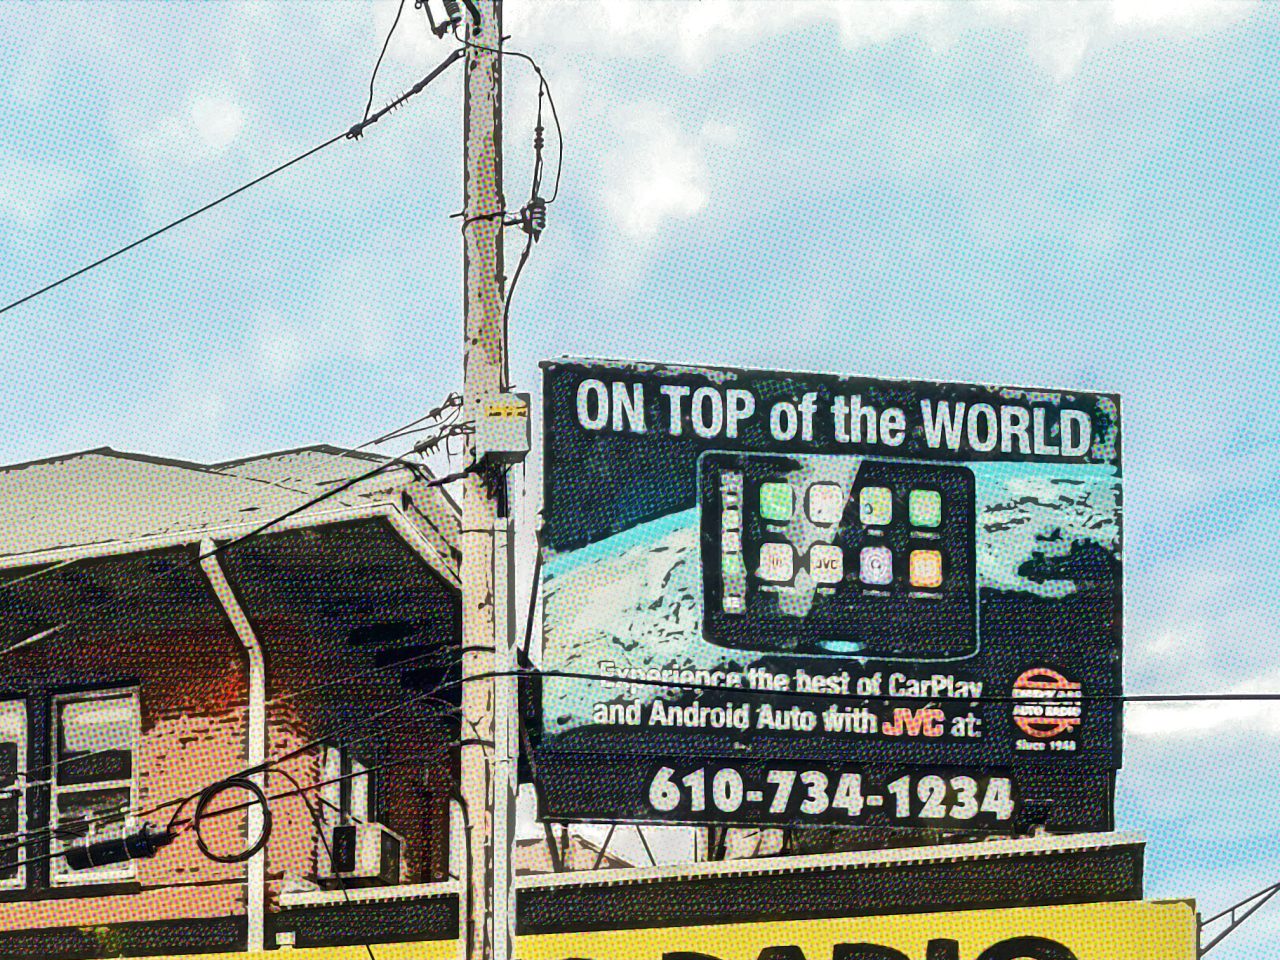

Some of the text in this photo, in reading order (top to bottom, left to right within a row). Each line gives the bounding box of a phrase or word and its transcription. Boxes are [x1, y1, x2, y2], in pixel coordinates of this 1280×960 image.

[577, 379, 1092, 458] ON TOP of the WORLD
[600, 661, 984, 705] Experience the best of CarPlay
[593, 699, 642, 726] and
[649, 700, 751, 730] Android
[756, 703, 817, 732] Auto
[822, 704, 878, 734] with
[882, 707, 945, 737] JVC
[648, 765, 1015, 821] 610-734-1234
